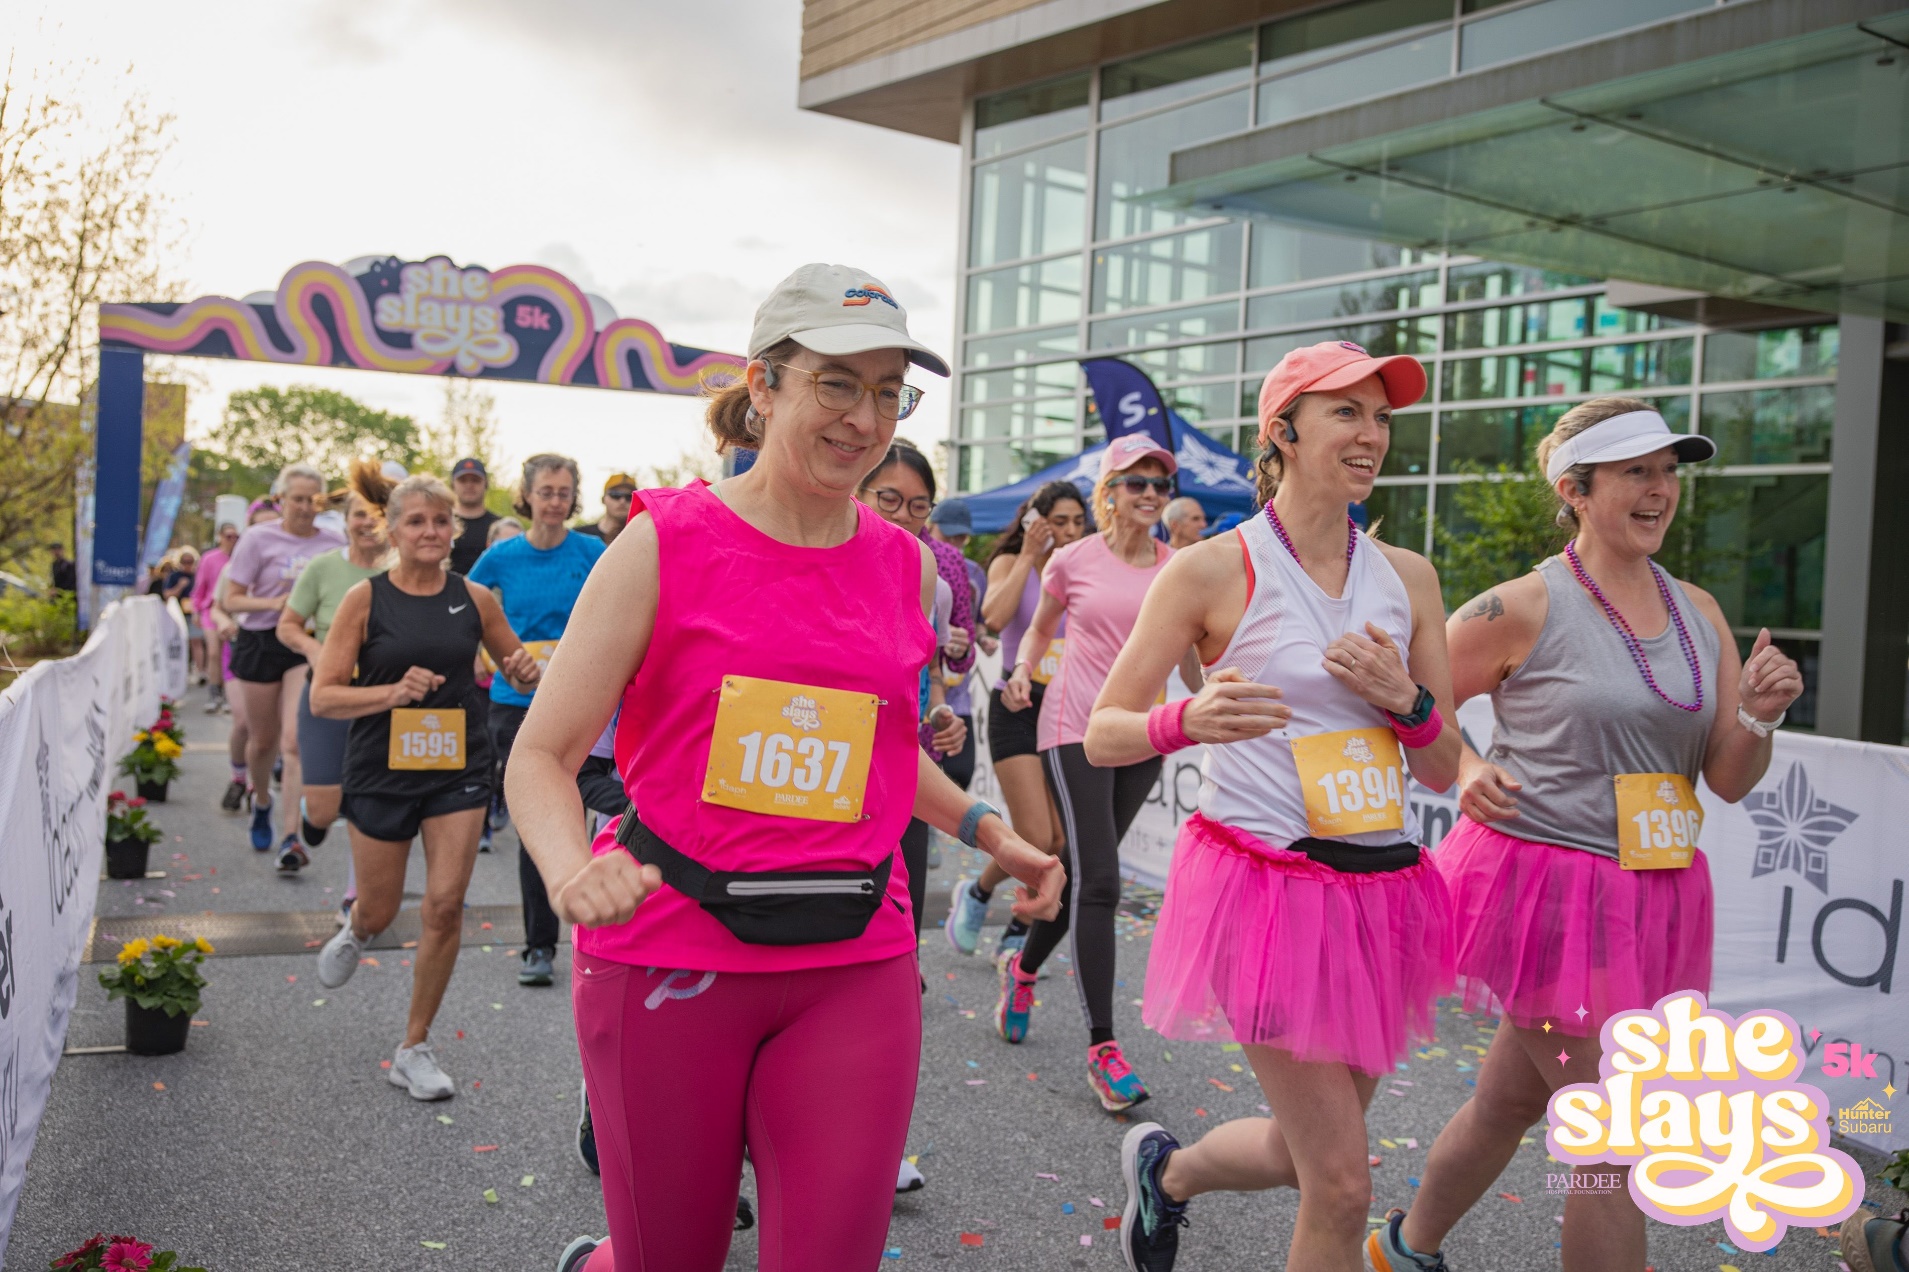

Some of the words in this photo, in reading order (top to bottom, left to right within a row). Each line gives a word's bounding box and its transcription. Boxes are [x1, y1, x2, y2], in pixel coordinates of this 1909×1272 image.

[407, 260, 489, 299] she
[377, 288, 514, 373] slays
[514, 304, 550, 330] 5k
[781, 705, 822, 731] slays
[791, 695, 816, 708] she
[399, 731, 458, 758] 1595
[738, 731, 851, 793] 1637
[1317, 766, 1403, 814] 1394
[1632, 808, 1699, 849] 1396
